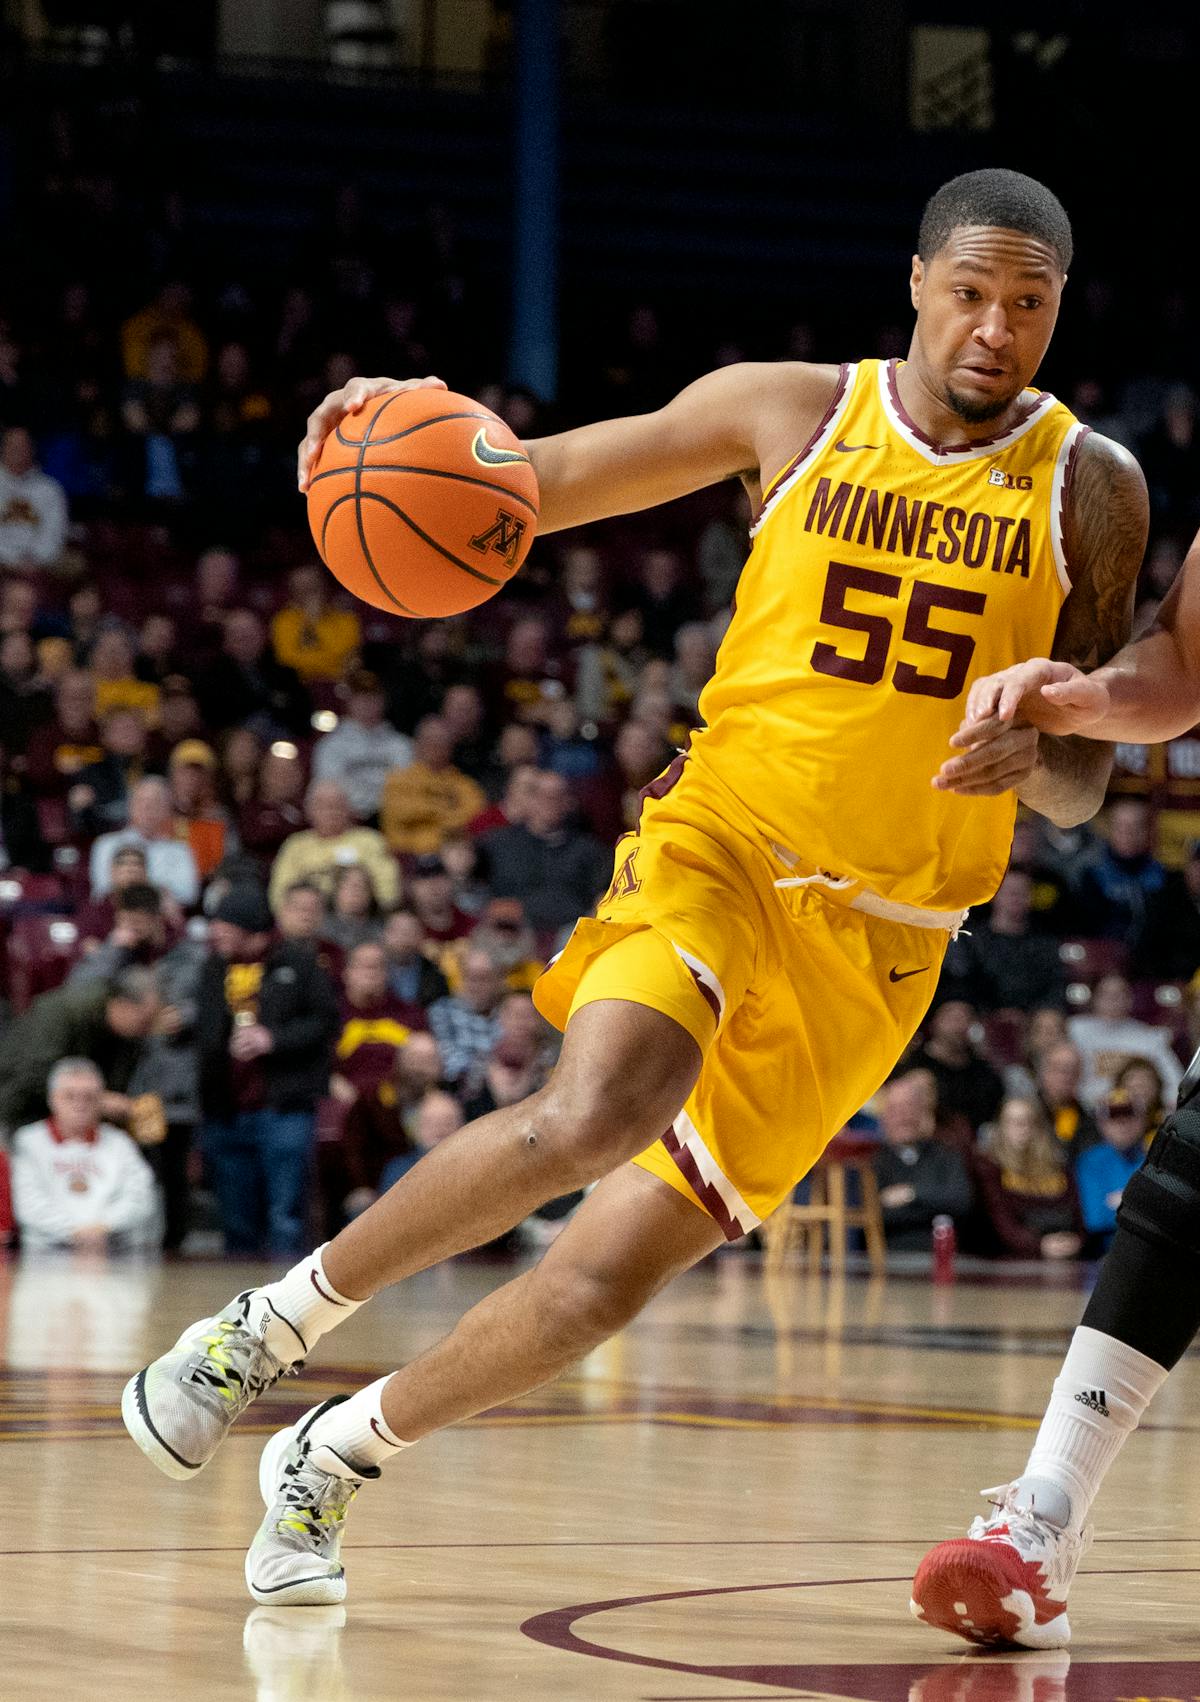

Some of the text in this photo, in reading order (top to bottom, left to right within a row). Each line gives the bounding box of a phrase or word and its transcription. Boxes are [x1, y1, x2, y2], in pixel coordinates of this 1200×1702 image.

[467, 508, 527, 569] M
[804, 478, 1031, 578] MINNESOTA
[810, 561, 987, 700] 55
[1074, 1394, 1110, 1417] adidas
